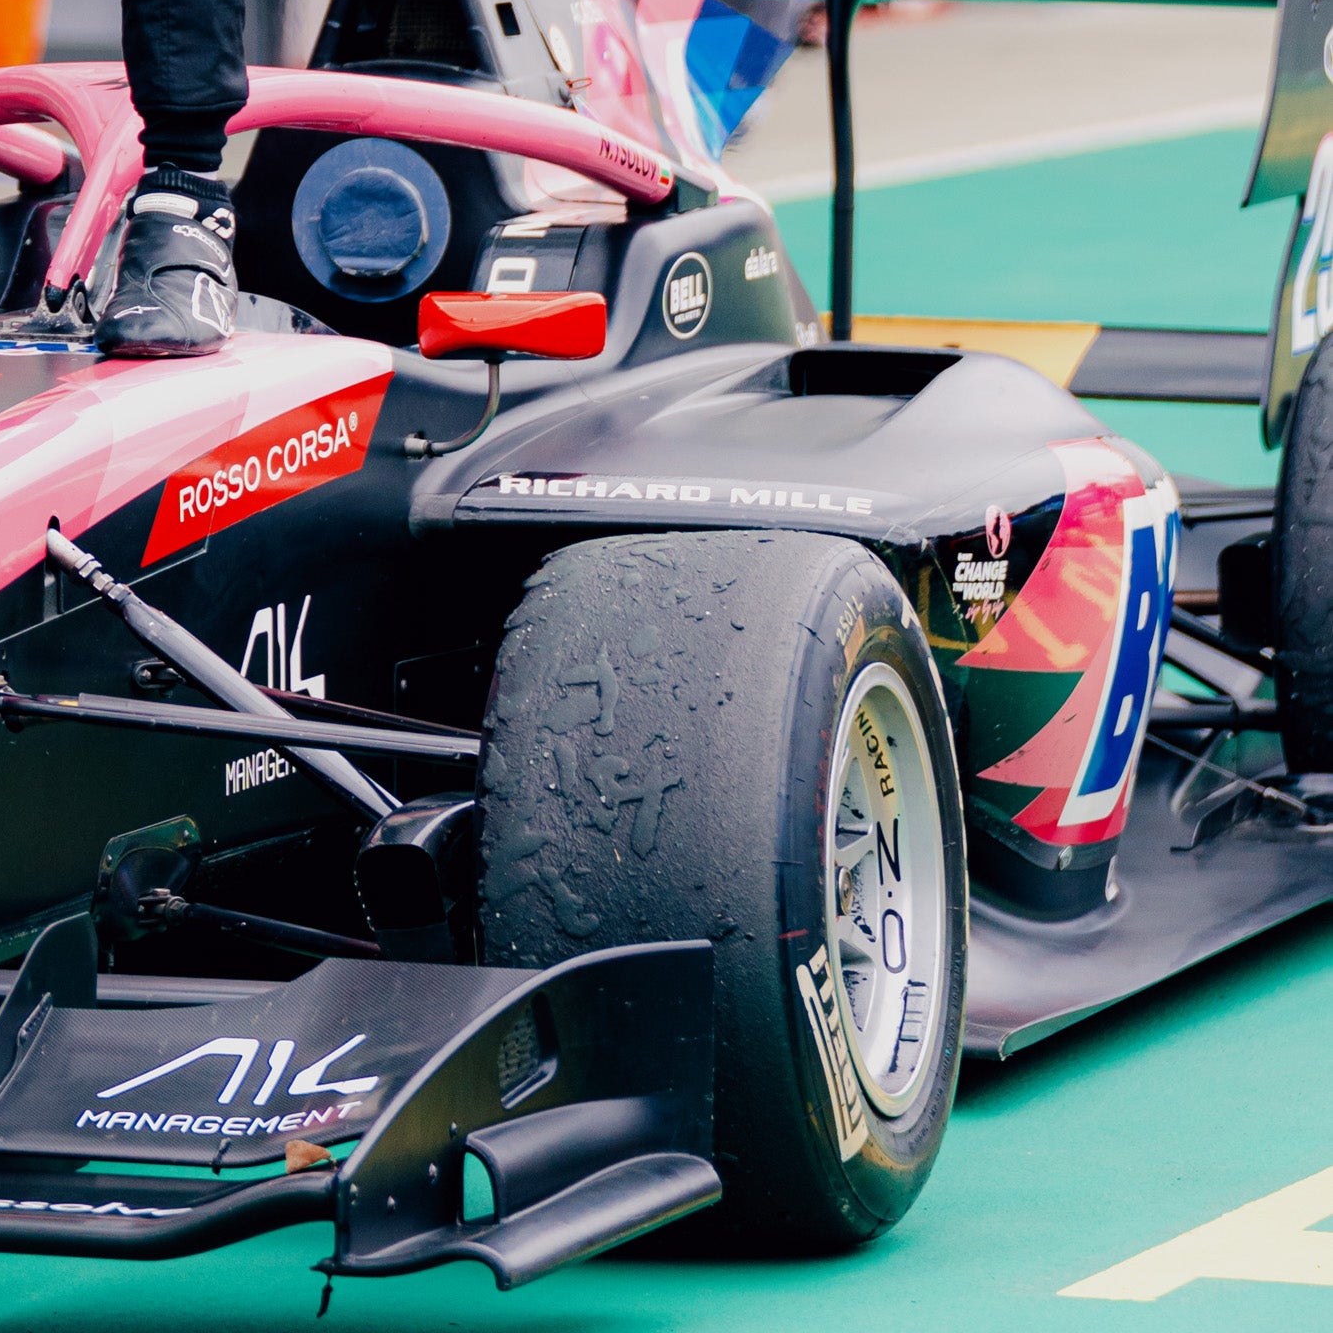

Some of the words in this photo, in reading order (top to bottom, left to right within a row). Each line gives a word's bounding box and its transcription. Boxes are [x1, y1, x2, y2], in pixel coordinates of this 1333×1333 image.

[670, 272, 707, 314] BELL
[179, 455, 261, 523] ROSSO
[499, 475, 712, 502] RICHARD
[730, 488, 874, 516] MILLE
[954, 560, 1009, 582] CHANGE
[962, 581, 1005, 601] WORLD
[854, 704, 896, 798] RACIN
[225, 748, 292, 796] MANAGE
[77, 1100, 364, 1136] MANAGEMENT
